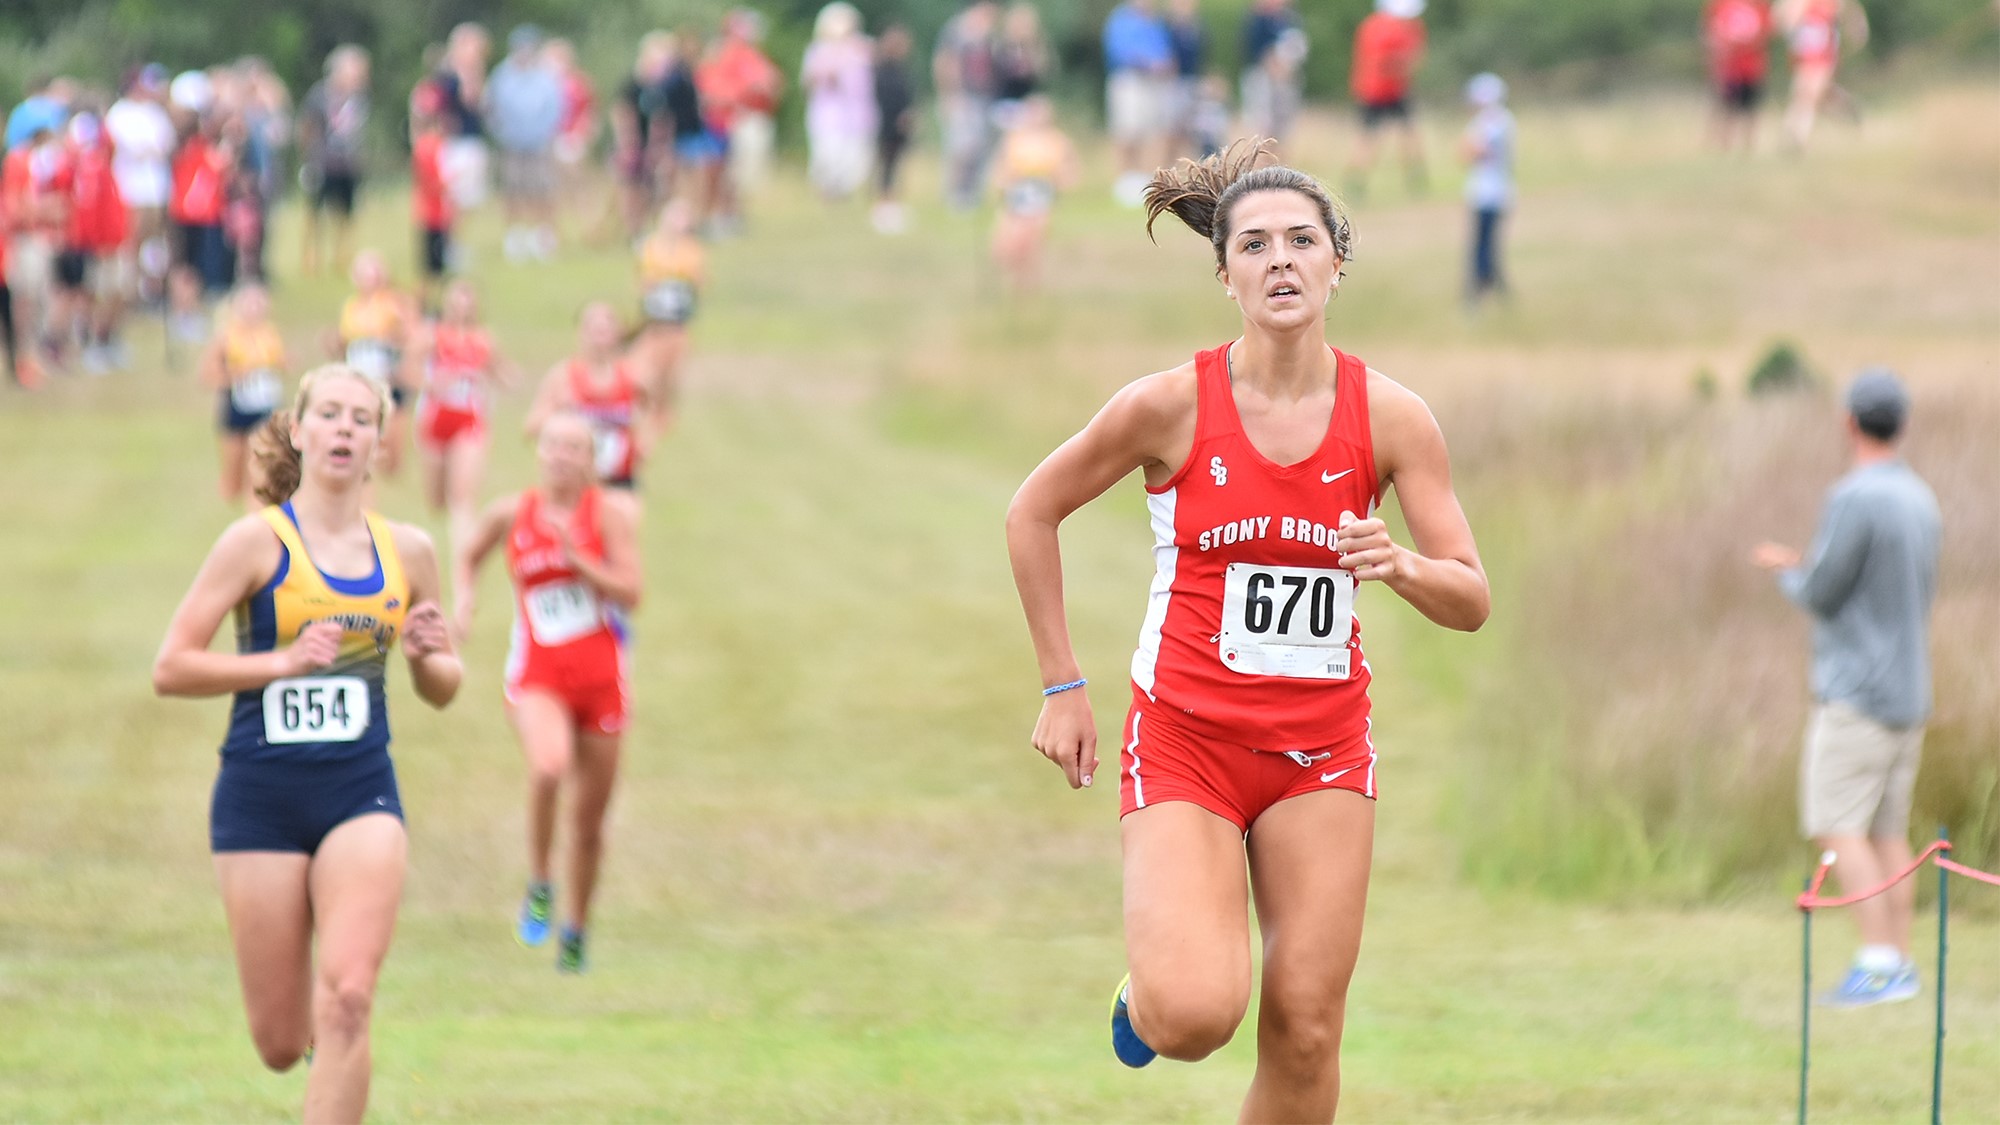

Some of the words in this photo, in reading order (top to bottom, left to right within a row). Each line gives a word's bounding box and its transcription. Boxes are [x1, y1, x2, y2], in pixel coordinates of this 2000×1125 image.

[1209, 455, 1229, 487] SB
[1198, 516, 1272, 552] STONY
[1280, 516, 1346, 556] BROO
[1244, 572, 1335, 638] 670
[281, 687, 350, 731] 654
